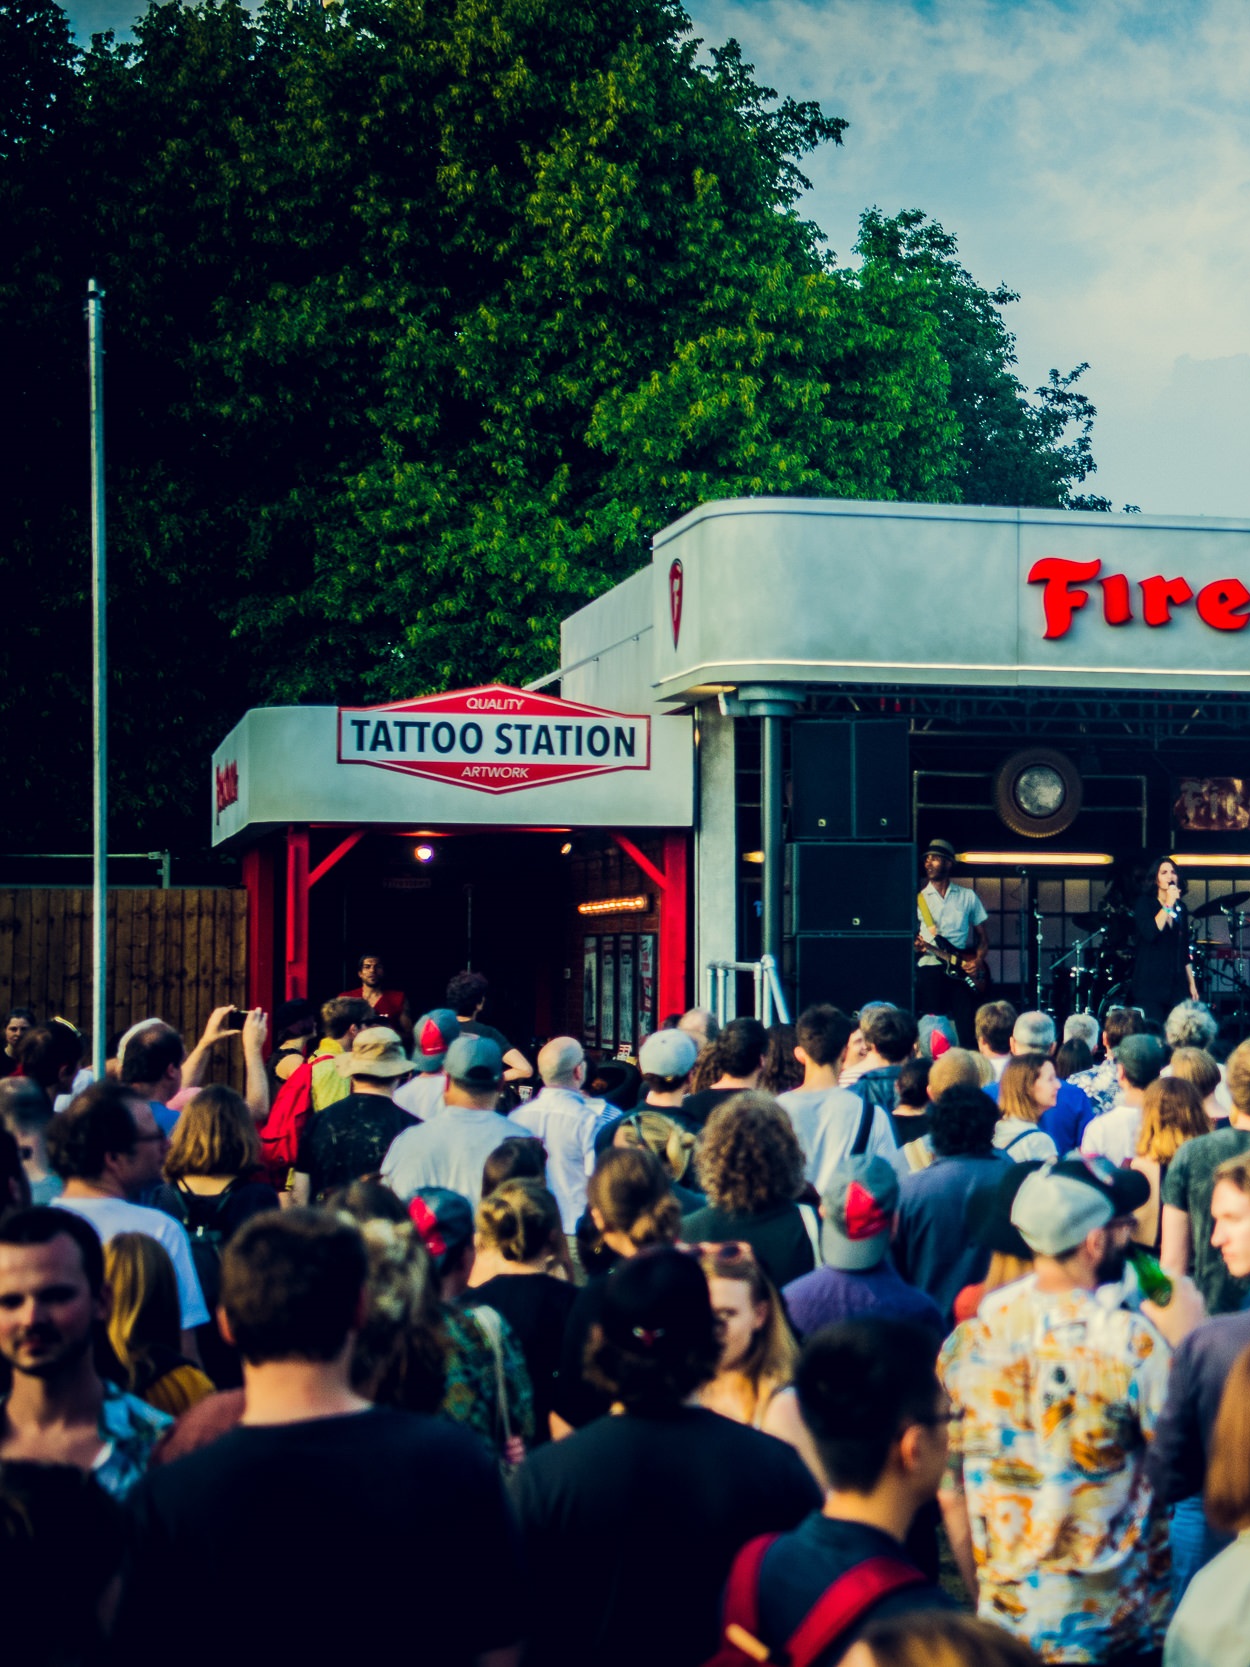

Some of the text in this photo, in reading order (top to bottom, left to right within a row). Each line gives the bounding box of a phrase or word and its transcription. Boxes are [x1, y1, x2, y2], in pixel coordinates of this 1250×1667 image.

[466, 697, 525, 711] QUALITY
[351, 719, 637, 758] TATTOO STATION
[461, 765, 530, 779] ARTWORK
